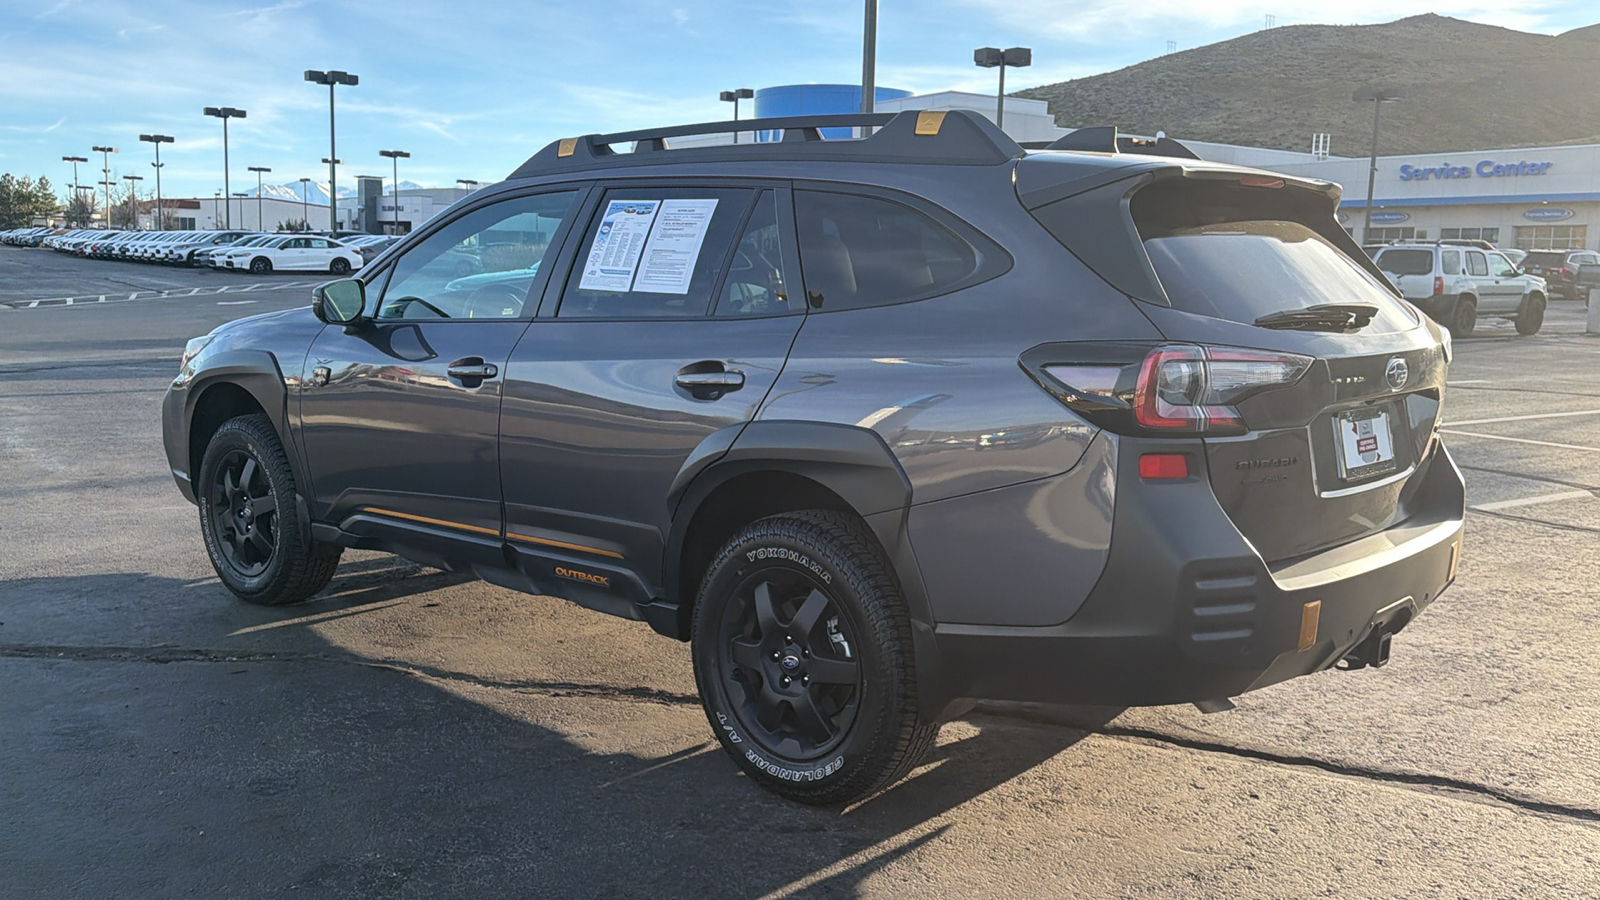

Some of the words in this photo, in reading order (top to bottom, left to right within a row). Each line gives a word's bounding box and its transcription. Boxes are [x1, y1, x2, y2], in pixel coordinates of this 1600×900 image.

[1399, 162, 1471, 181] Service
[1475, 160, 1553, 178] Center
[554, 566, 610, 586] OUTBACK
[746, 547, 832, 585] YOKOHAMA
[715, 711, 743, 744] A/T
[745, 748, 845, 782] GEOLANDAR
